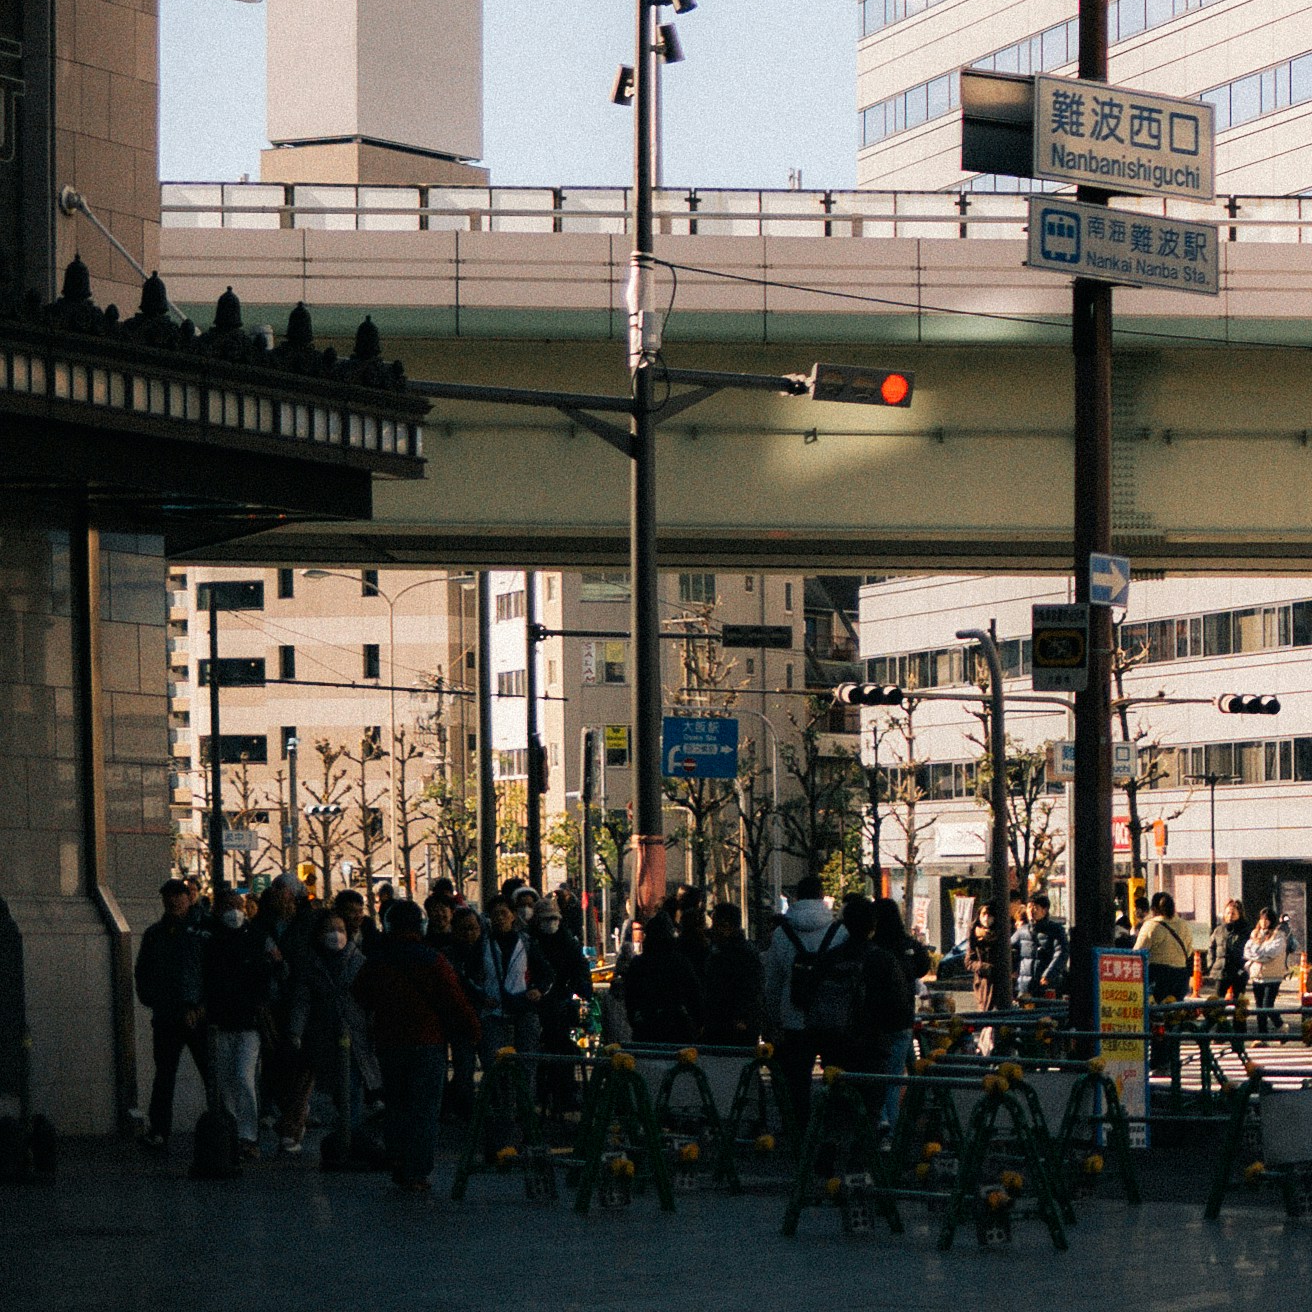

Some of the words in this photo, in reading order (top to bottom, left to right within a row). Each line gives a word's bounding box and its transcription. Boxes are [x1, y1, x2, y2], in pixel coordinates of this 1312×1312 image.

[1051, 89, 1200, 156] 難波西口
[1051, 142, 1200, 190] Nanbanishiguchi
[1087, 216, 1208, 263] 南海難波駅
[1086, 251, 1132, 274] Nankai
[1136, 256, 1178, 280] Nanba
[1183, 265, 1210, 285] Sta.
[1102, 959, 1141, 979] 工事予告
